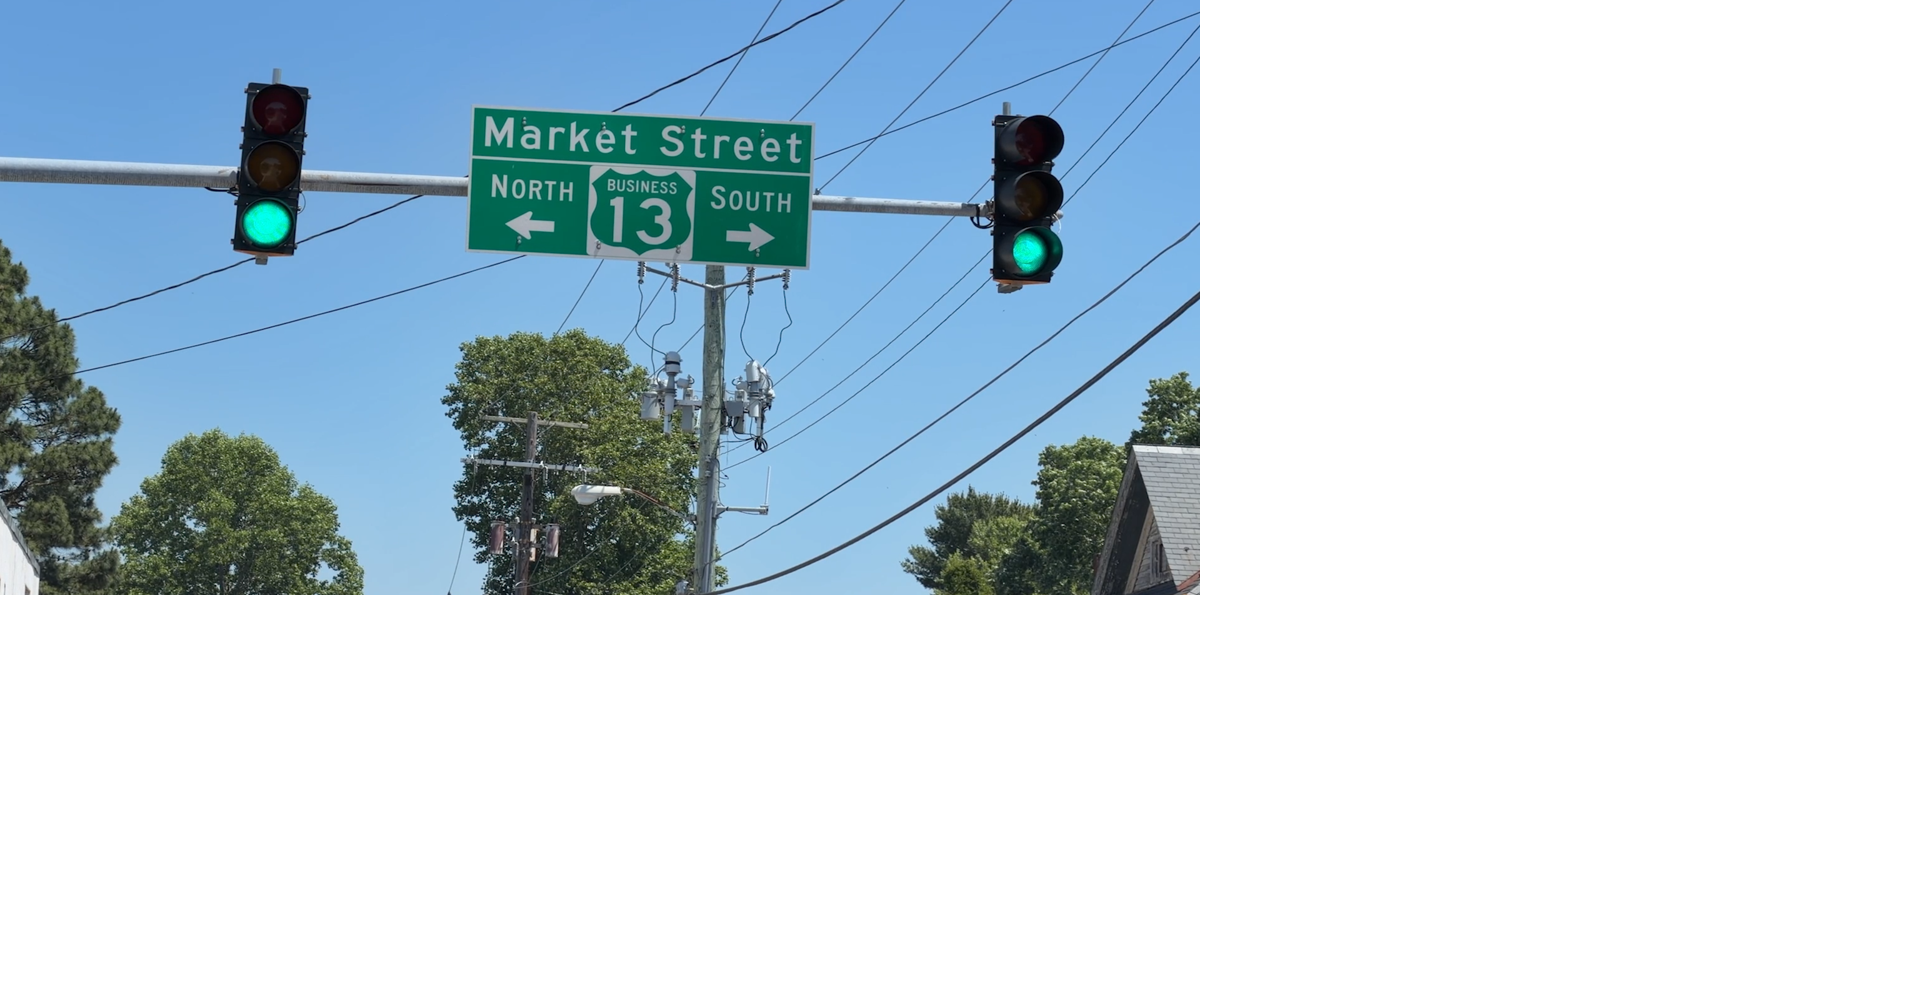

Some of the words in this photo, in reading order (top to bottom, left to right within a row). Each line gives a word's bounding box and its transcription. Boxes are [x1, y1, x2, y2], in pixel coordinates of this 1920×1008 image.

[484, 115, 638, 155] Market
[659, 125, 803, 164] Street
[490, 173, 574, 202] NORTH
[606, 178, 678, 195] BUSINESS
[710, 186, 792, 213] SOUTH
[609, 196, 673, 245] 13
